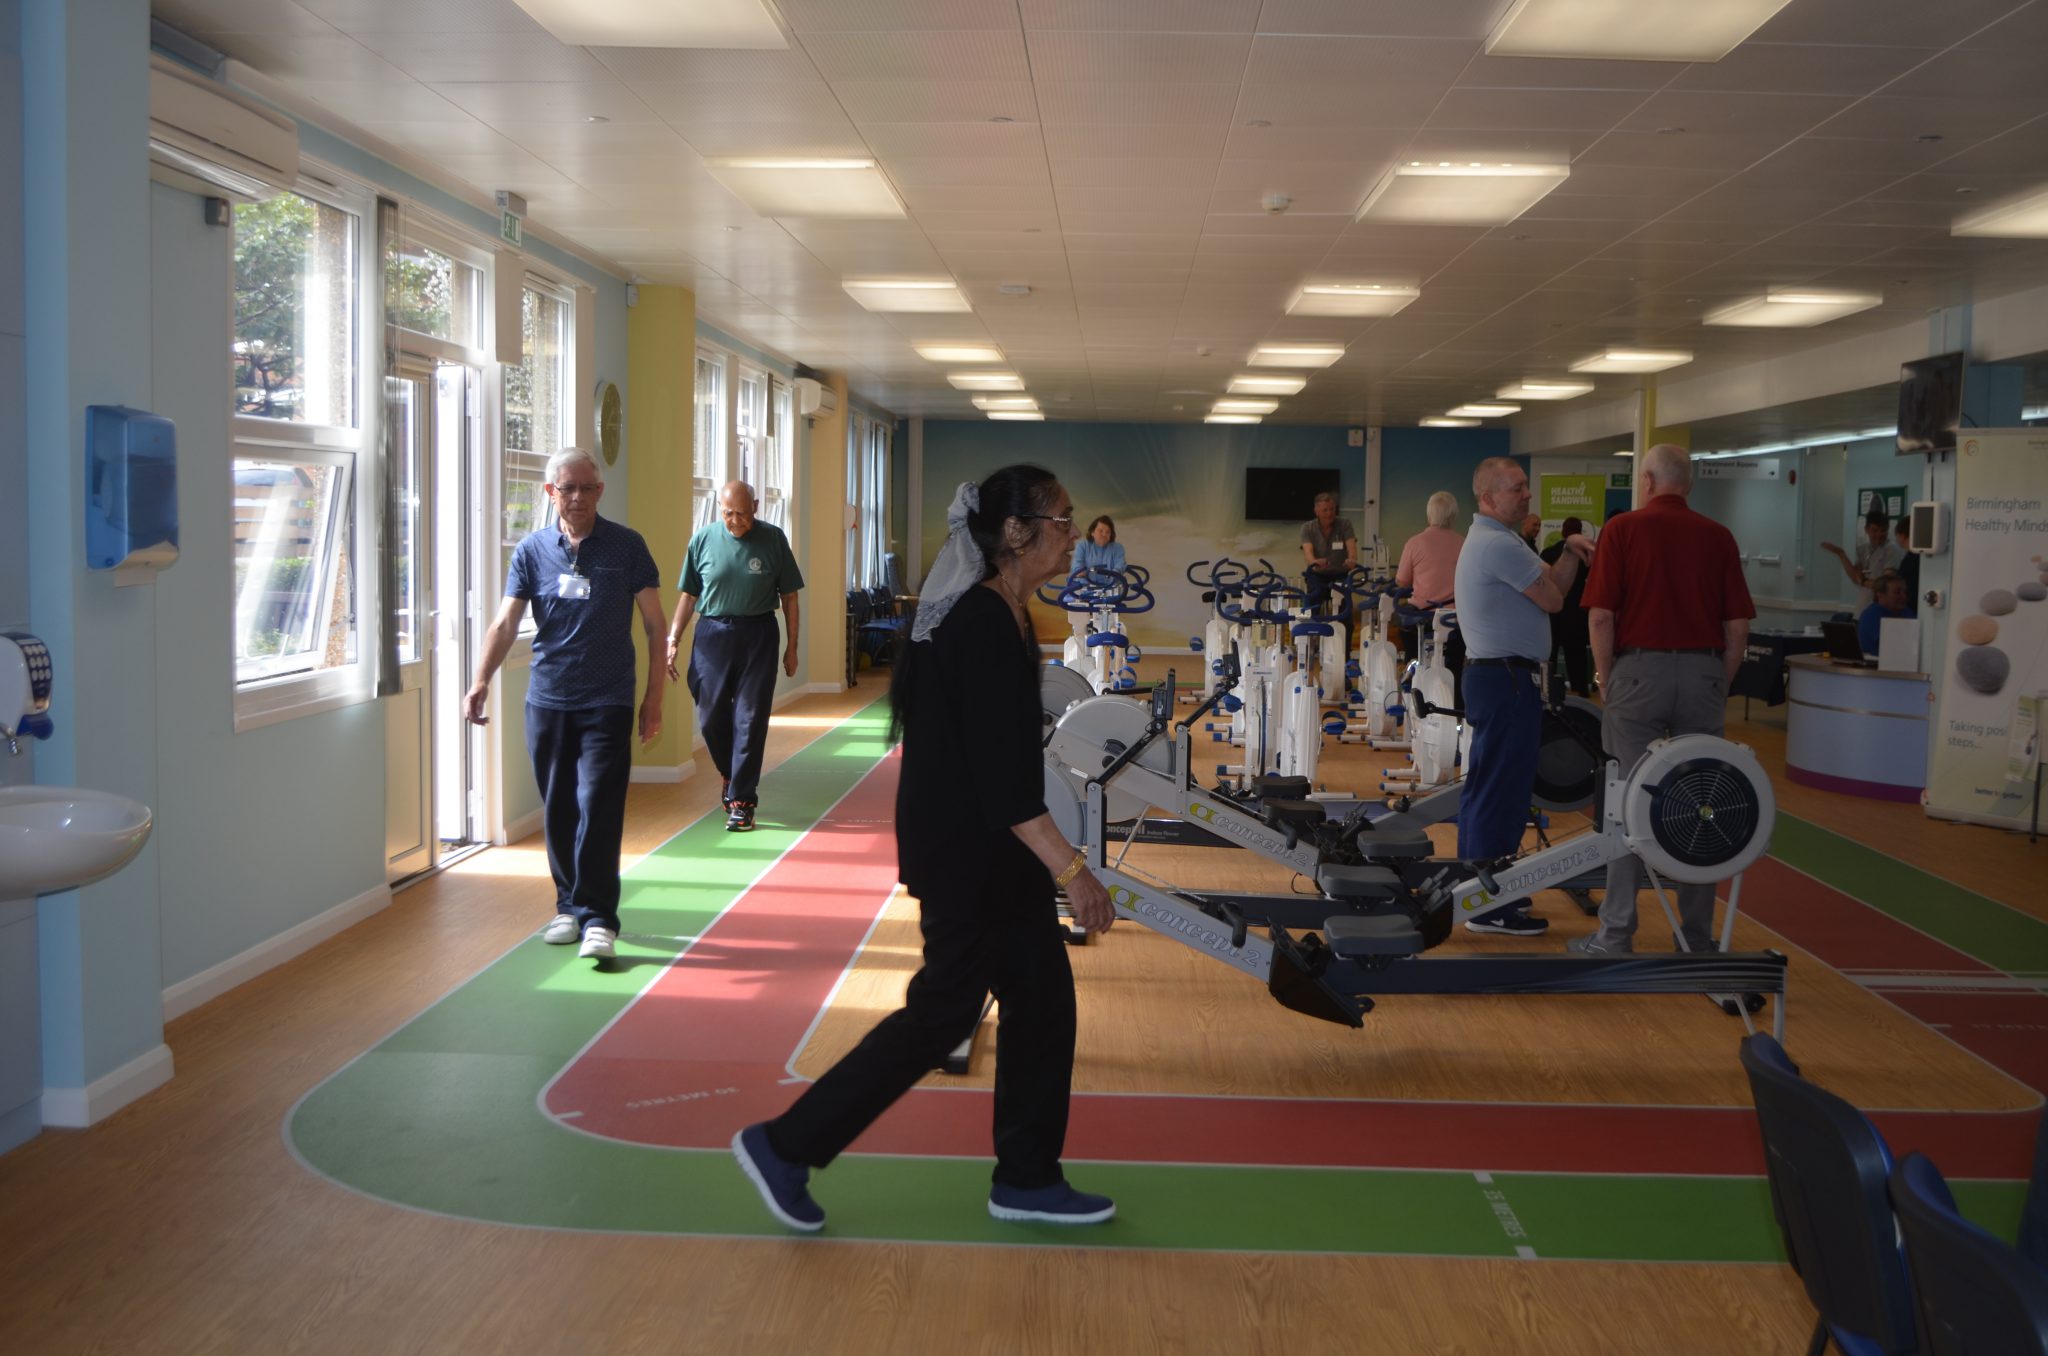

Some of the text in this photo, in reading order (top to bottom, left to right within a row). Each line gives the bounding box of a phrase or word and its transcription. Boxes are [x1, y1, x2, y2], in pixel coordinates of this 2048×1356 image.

[1551, 484, 1585, 496] HEALTHY
[1551, 496, 1593, 505] SANDWELL
[1967, 497, 2040, 512] Birmingham
[1965, 518, 2012, 534] Healthy
[1949, 720, 1984, 735] Taking
[1585, 845, 1600, 862] 2
[1242, 949, 1261, 968] 2
